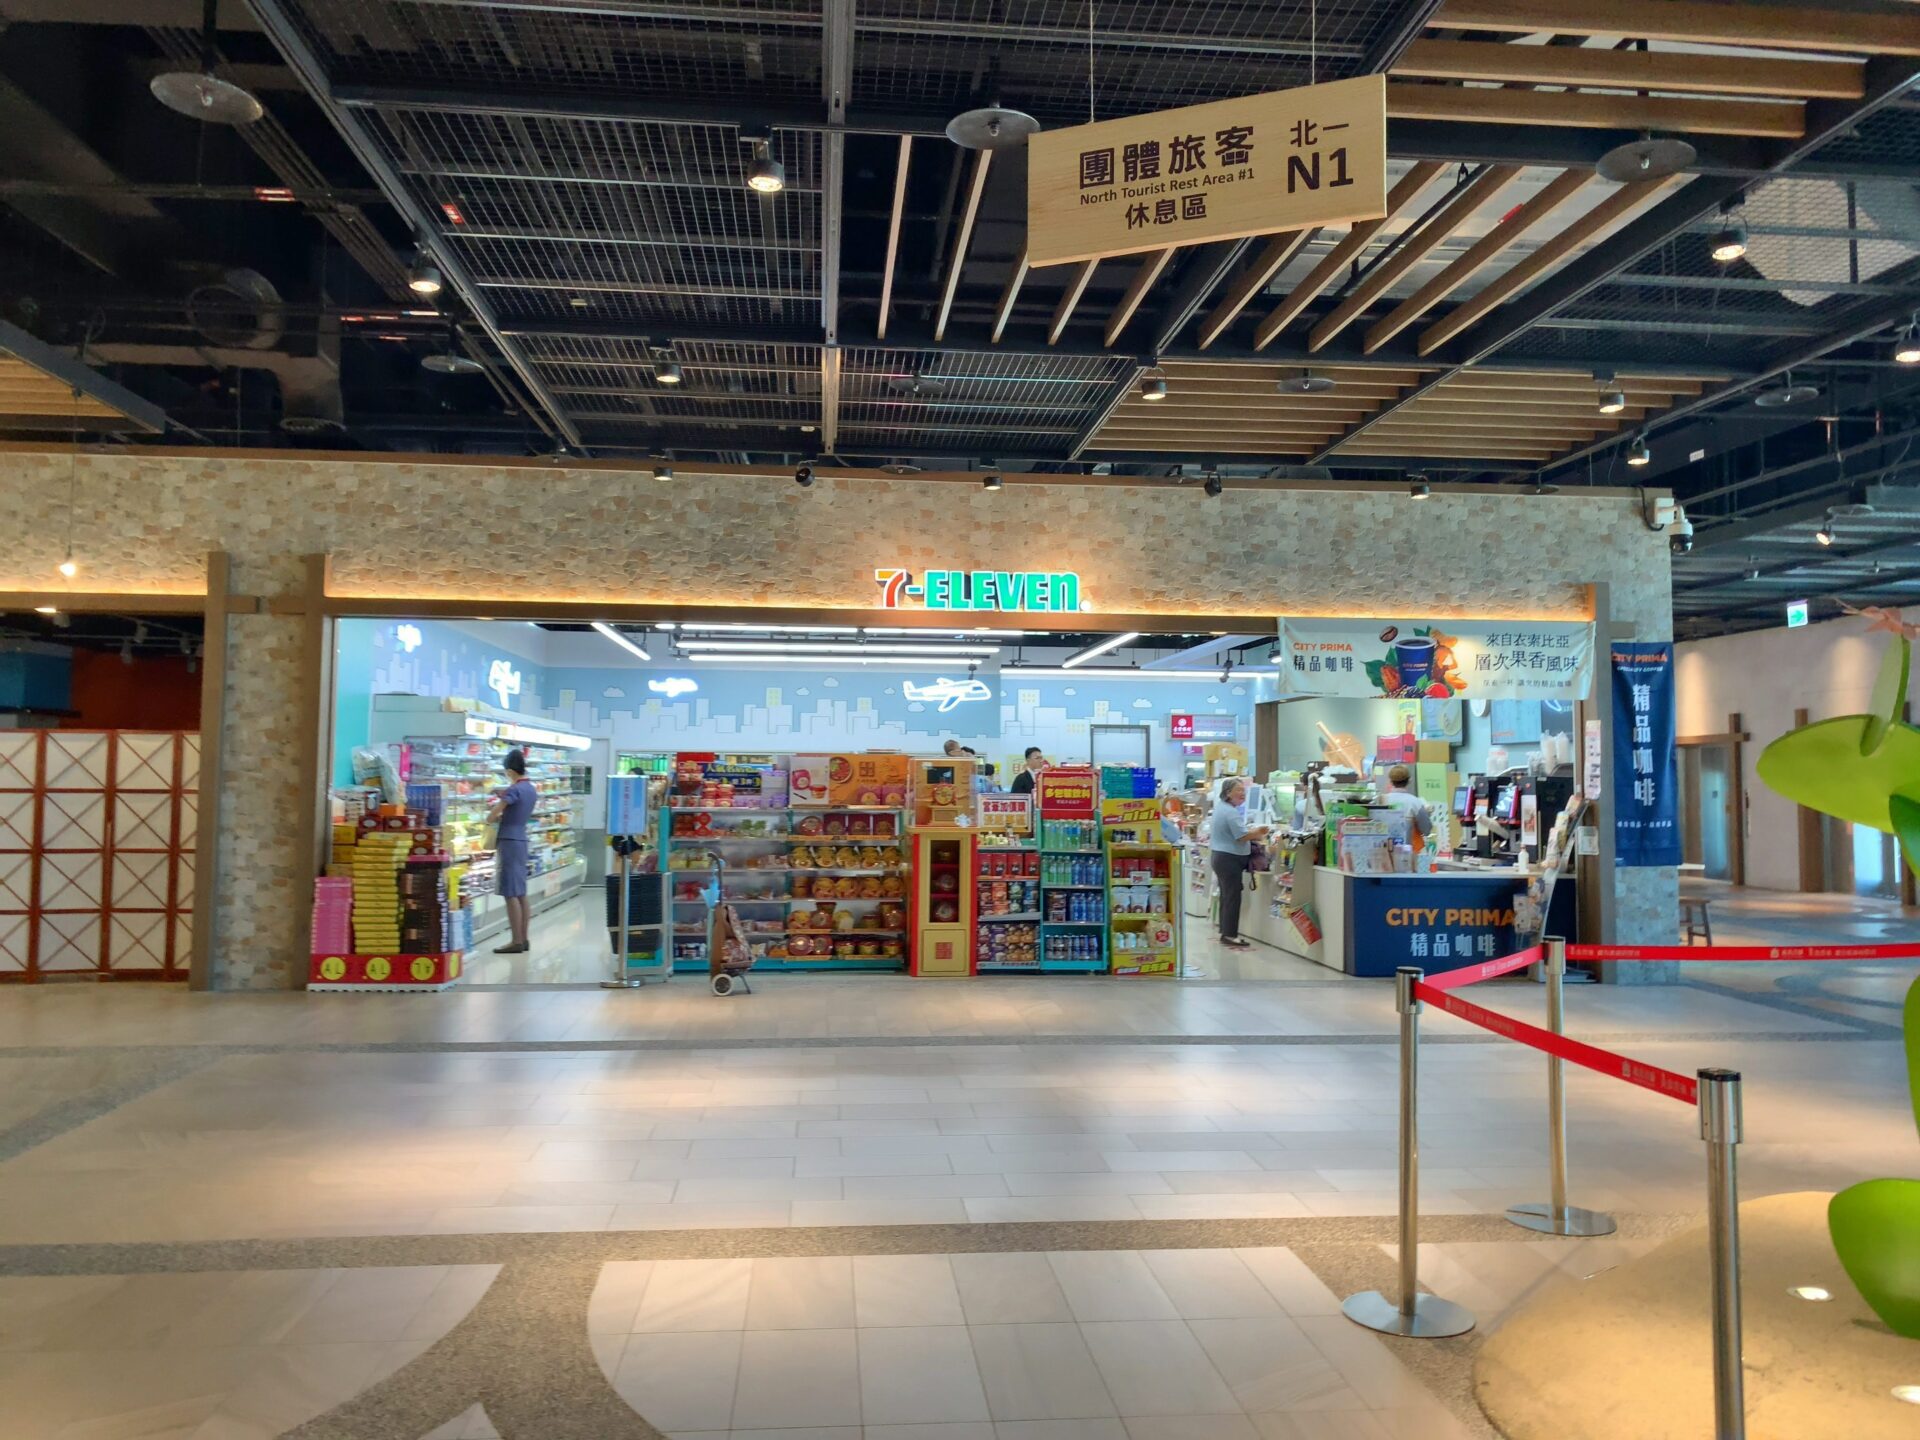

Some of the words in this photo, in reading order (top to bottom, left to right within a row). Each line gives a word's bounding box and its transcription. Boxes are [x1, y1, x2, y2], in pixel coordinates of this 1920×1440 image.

[1290, 119, 1350, 148] 北一
[1080, 126, 1254, 189] 團體旅客
[1287, 147, 1354, 194] N1
[1080, 188, 1117, 205] North
[1121, 182, 1166, 199] Tourist
[1169, 177, 1199, 192] Rest
[1202, 173, 1235, 187] Area
[1238, 168, 1255, 182] #1
[1125, 193, 1208, 230] 休息區
[1293, 642, 1316, 652] CITY
[1320, 643, 1353, 652] PRIMA
[1486, 633, 1570, 648] 來自衣索比亞
[1293, 655, 1353, 672] 精品咖啡
[1475, 650, 1579, 672] 層次果香風味
[1635, 653, 1668, 662] PRIMA
[1632, 683, 1654, 806] 精品咖啡
[1386, 908, 1440, 926] CITY
[1445, 909, 1515, 926] PRIMA
[1411, 932, 1496, 957] 精品咖啡
